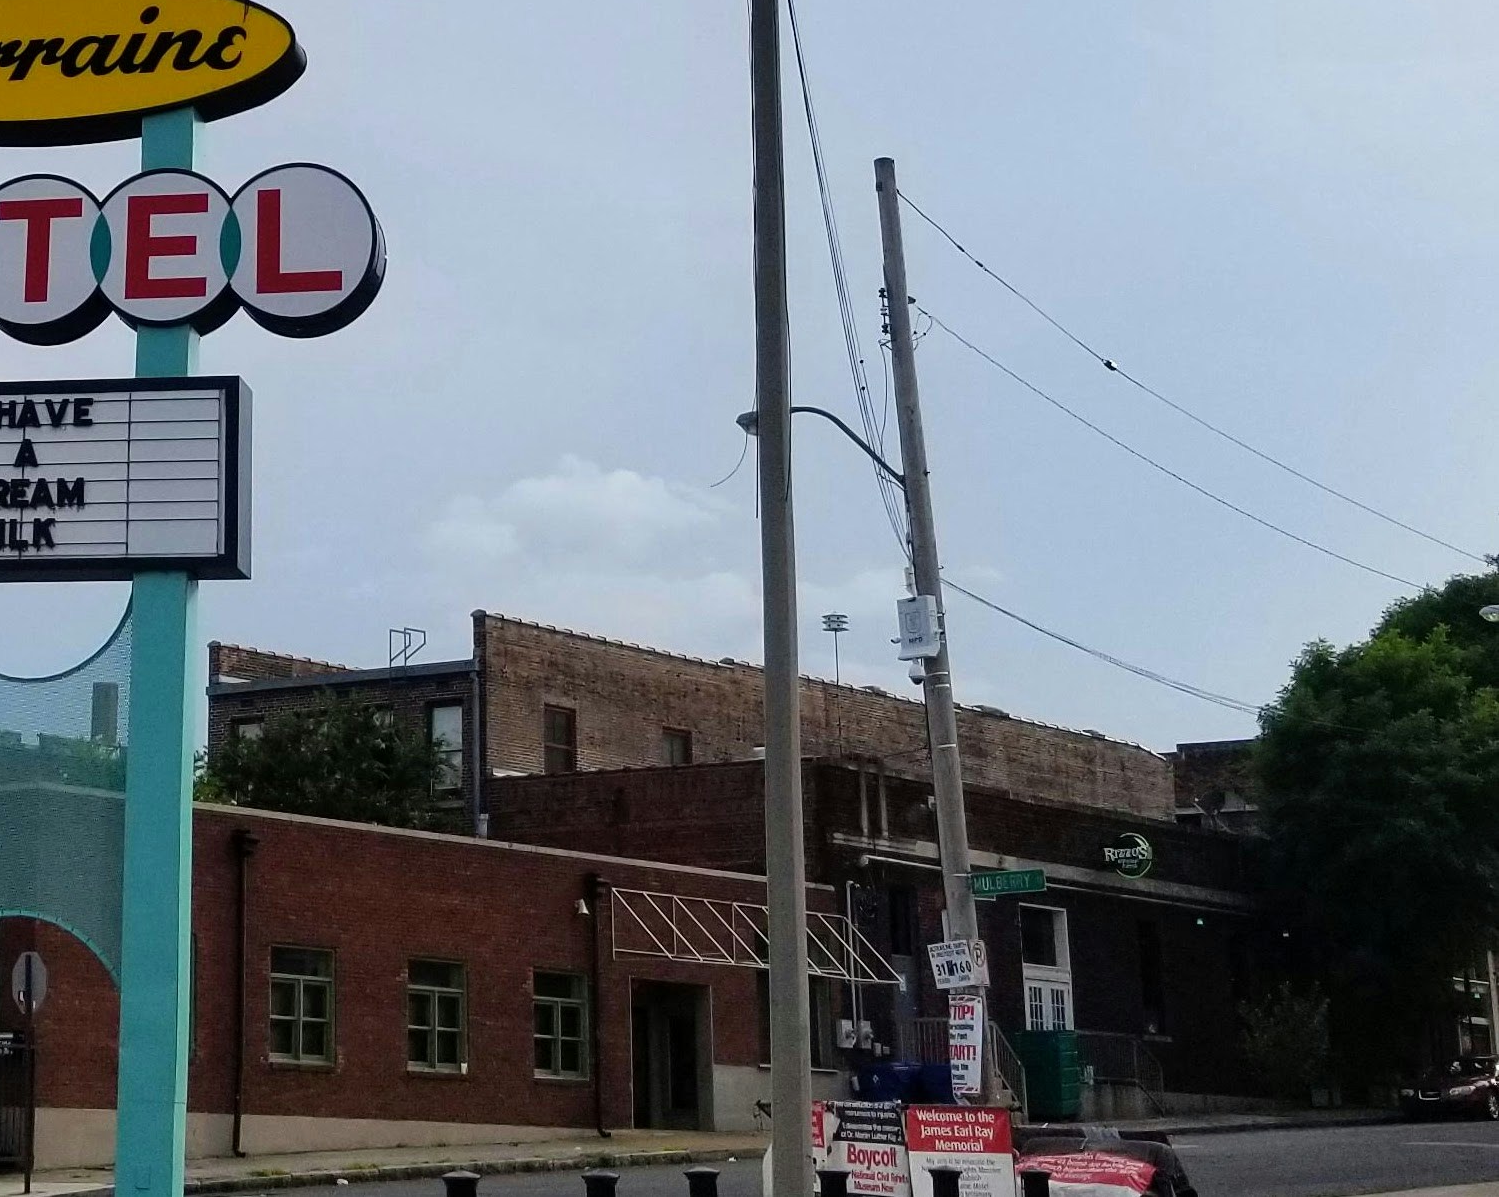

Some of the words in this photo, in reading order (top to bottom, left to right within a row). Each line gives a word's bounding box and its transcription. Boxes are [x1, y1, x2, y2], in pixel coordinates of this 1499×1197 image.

[13, 438, 39, 467] A
[974, 874, 1030, 892] MULBERRY
[951, 1005, 975, 1021] TOP!
[915, 1109, 963, 1122] Welcome
[964, 1111, 976, 1123] to
[977, 1111, 995, 1123] the
[920, 1124, 952, 1139] James
[953, 1125, 973, 1138] Earl
[974, 1126, 994, 1141] Ray
[935, 1139, 984, 1152] Memorial
[847, 1143, 897, 1170] Boycott
